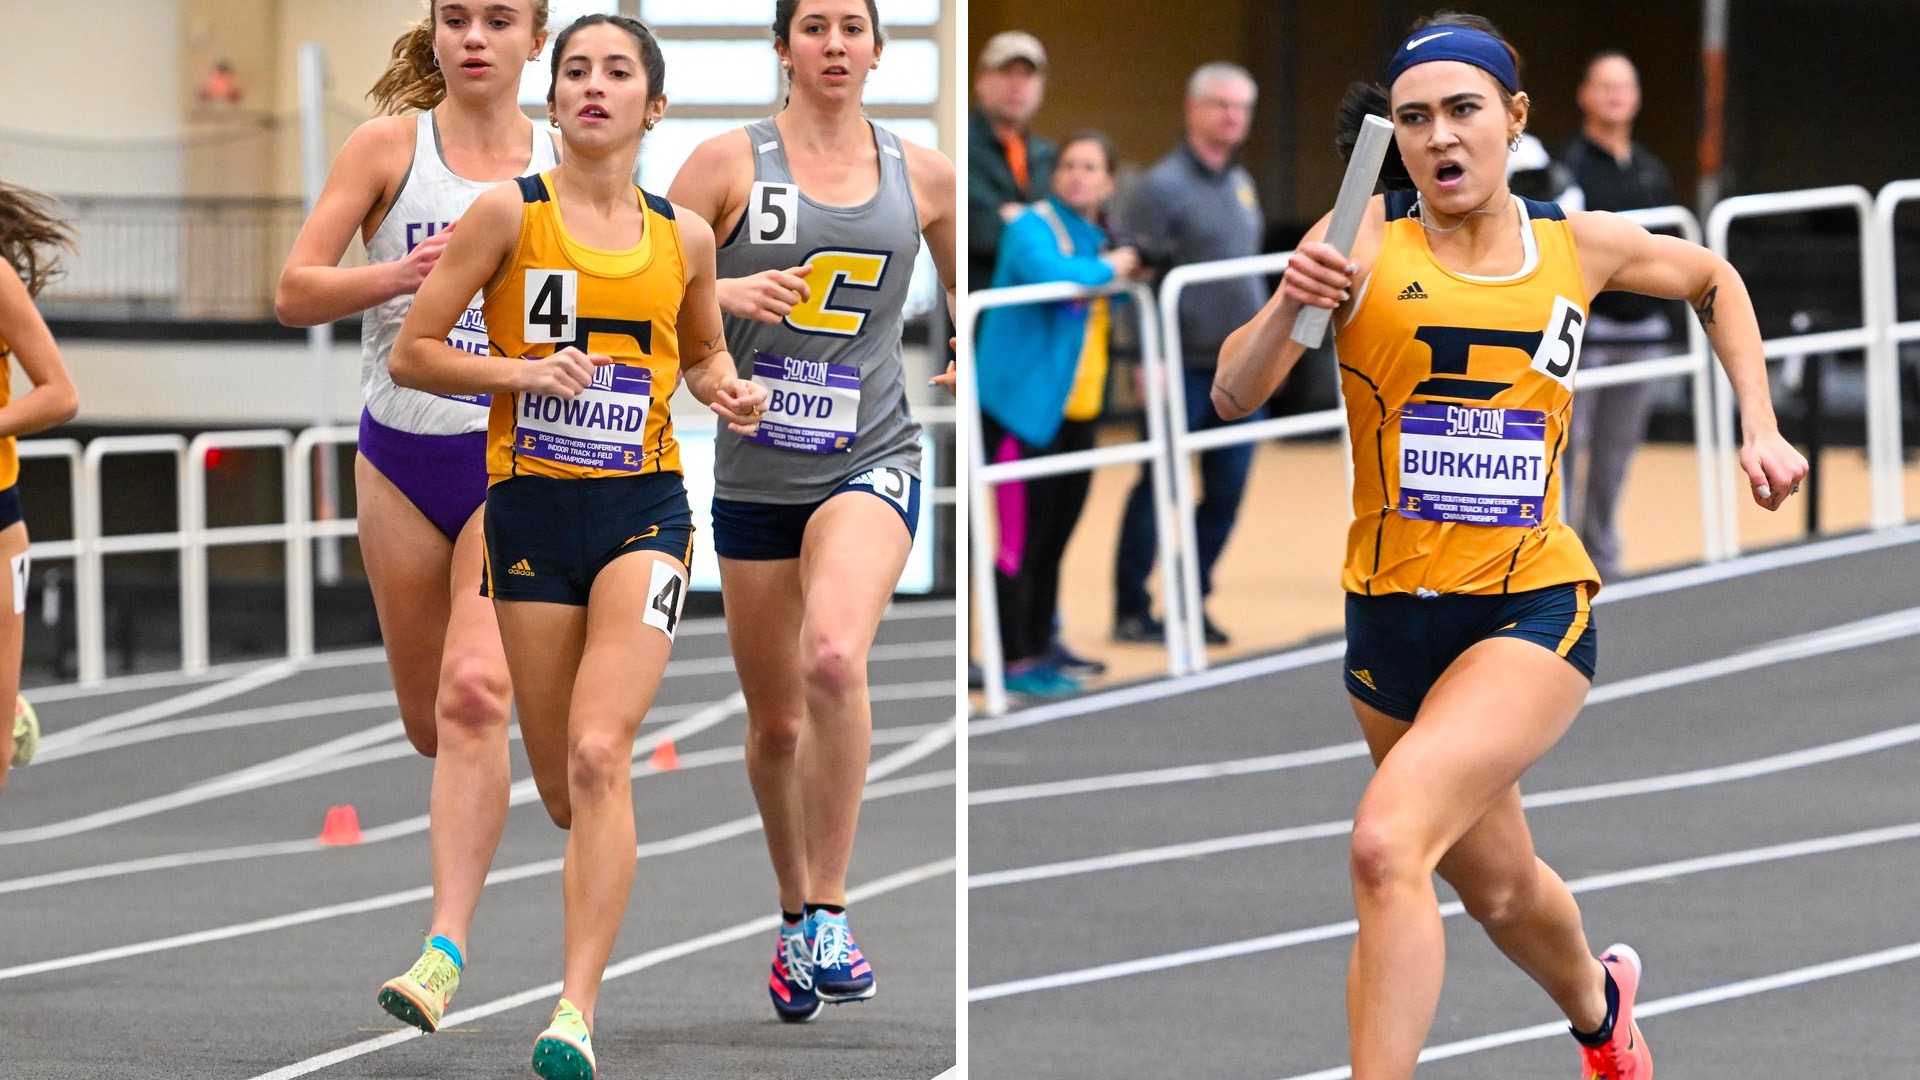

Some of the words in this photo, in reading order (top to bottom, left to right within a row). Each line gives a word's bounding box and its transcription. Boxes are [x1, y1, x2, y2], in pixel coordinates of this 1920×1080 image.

[760, 186, 788, 241] 5
[783, 246, 893, 339] C
[1397, 293, 1428, 301] adidas
[528, 274, 568, 338] 4
[1545, 306, 1582, 378] 5
[783, 356, 828, 386] SOCON
[523, 392, 643, 433] HOWARD
[769, 389, 833, 419] BOYD
[1445, 405, 1506, 438] SOCON
[774, 425, 800, 435] SOUTHERN
[801, 429, 836, 439] CONFERENCE
[787, 434, 805, 442] TRACK
[811, 436, 826, 444] FIELD
[538, 433, 554, 443] 2023
[555, 436, 586, 449] SOUTHERN
[587, 442, 622, 453] CONFERENCE
[547, 444, 569, 453] INDOOR
[570, 448, 590, 457] TRACK
[597, 451, 613, 459] FIELD
[773, 439, 818, 451] CHAMPIONSHIPS
[554, 453, 604, 466] CHAMPIONSHIPS
[1403, 448, 1542, 481] BURKHART
[1422, 493, 1440, 502] 2023
[1441, 495, 1477, 504] SOUTHERN
[1477, 498, 1520, 506] CONFERENCE
[1433, 503, 1458, 512] INDOOR
[1459, 505, 1483, 514] TRACK
[1442, 512, 1498, 523] CHAMPIONSHIPS
[507, 568, 535, 577] adidas
[652, 574, 682, 634] 4
